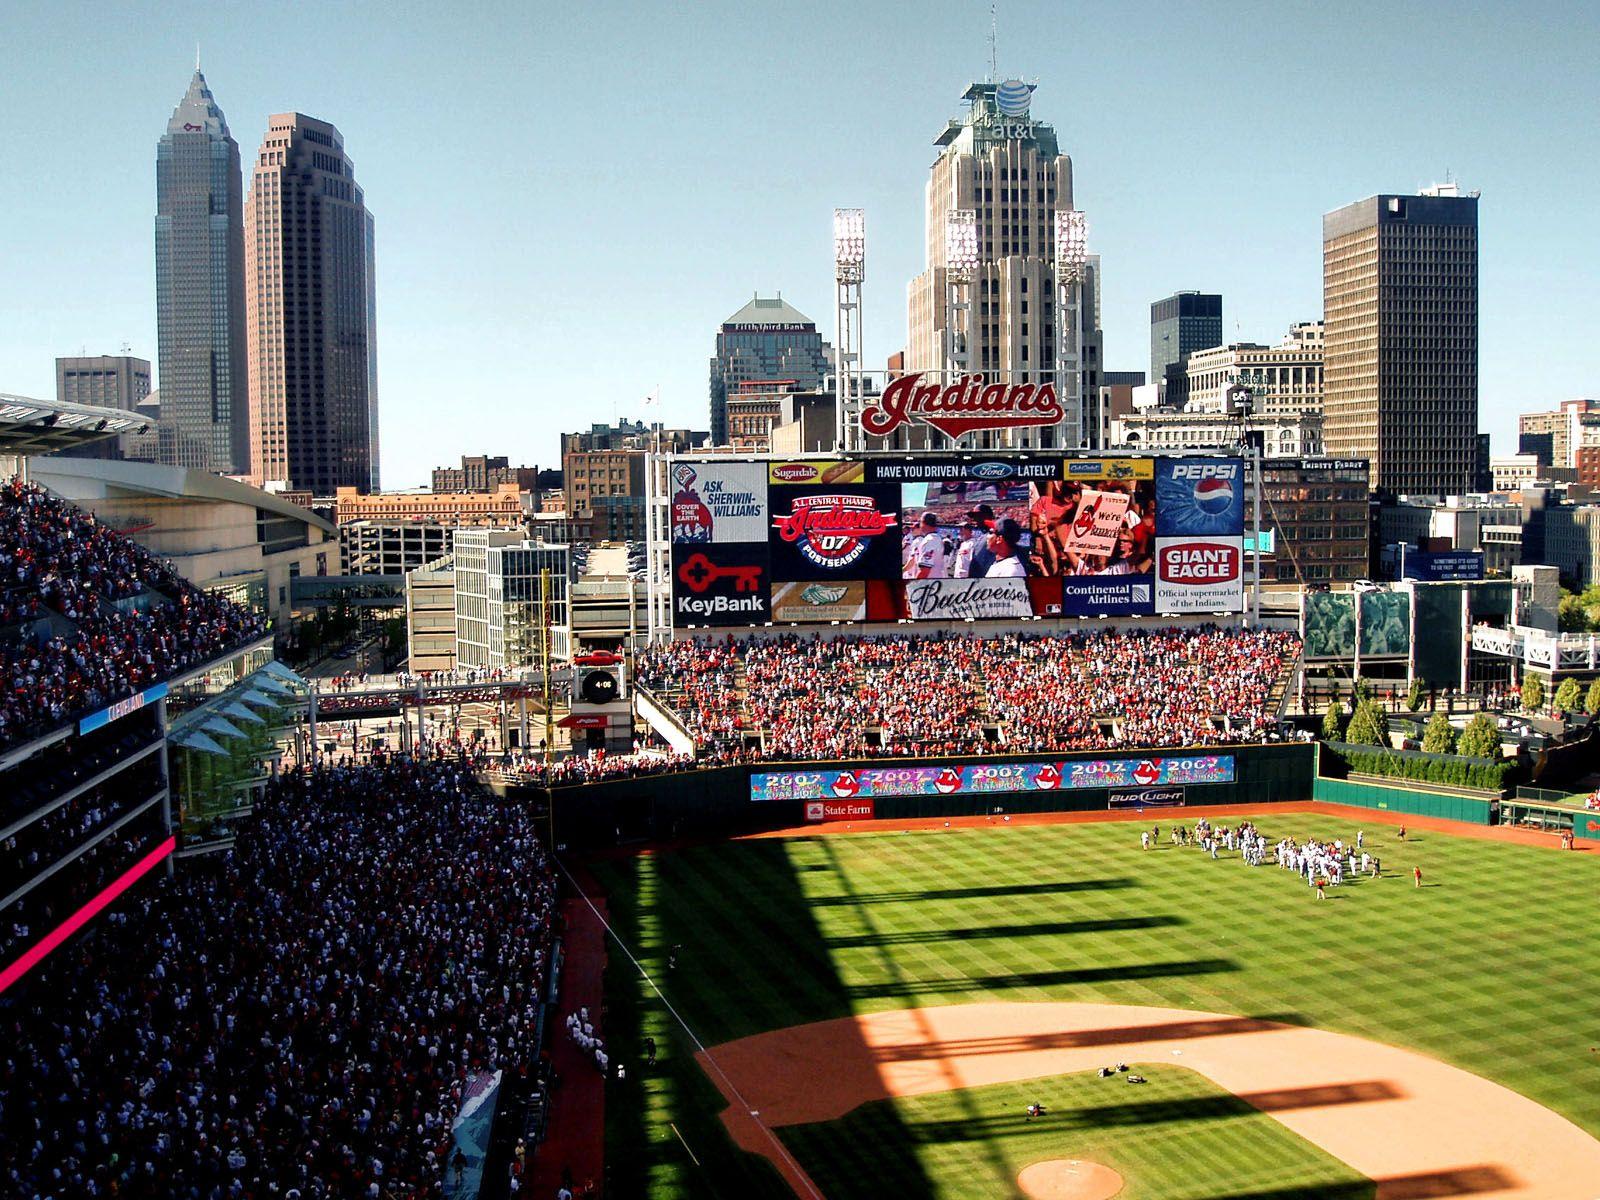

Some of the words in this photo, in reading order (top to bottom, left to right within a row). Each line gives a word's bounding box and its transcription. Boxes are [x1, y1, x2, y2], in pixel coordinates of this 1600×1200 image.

[992, 118, 1036, 139] at&t
[861, 372, 1065, 438] Indians
[773, 467, 817, 479] Sugardale
[877, 466, 901, 477] HAVE
[903, 466, 923, 477] YOU
[925, 465, 959, 477] DRIVEN
[960, 465, 967, 476] A
[979, 464, 1005, 476] Ford
[1018, 465, 1056, 477] LATELY?
[1172, 465, 1237, 479] PEPSI
[703, 481, 723, 492] ASK
[707, 493, 755, 505] SHERWIN-
[809, 497, 840, 505] CENTRAL
[842, 497, 873, 507] CHAMPS
[1098, 512, 1121, 521] We're
[780, 505, 886, 541] Indians
[802, 542, 865, 568] POSTSEASON
[1166, 550, 1231, 563] GIANT
[1168, 563, 1230, 578] EAGLE
[1066, 585, 1129, 595] Continental
[1158, 589, 1188, 598] Official
[1190, 589, 1239, 599] supermarket
[910, 580, 1028, 616] Budweiser
[1088, 594, 1130, 604] Airlines
[678, 596, 764, 616] KeyBank
[1072, 763, 1125, 774] 2007
[1168, 759, 1218, 771] 2007
[871, 772, 923, 782] 2007
[972, 767, 1025, 779] 2007
[766, 775, 821, 786] 2007
[1144, 792, 1183, 800] LIGHT
[825, 806, 846, 815] State
[847, 805, 871, 815] Farm
